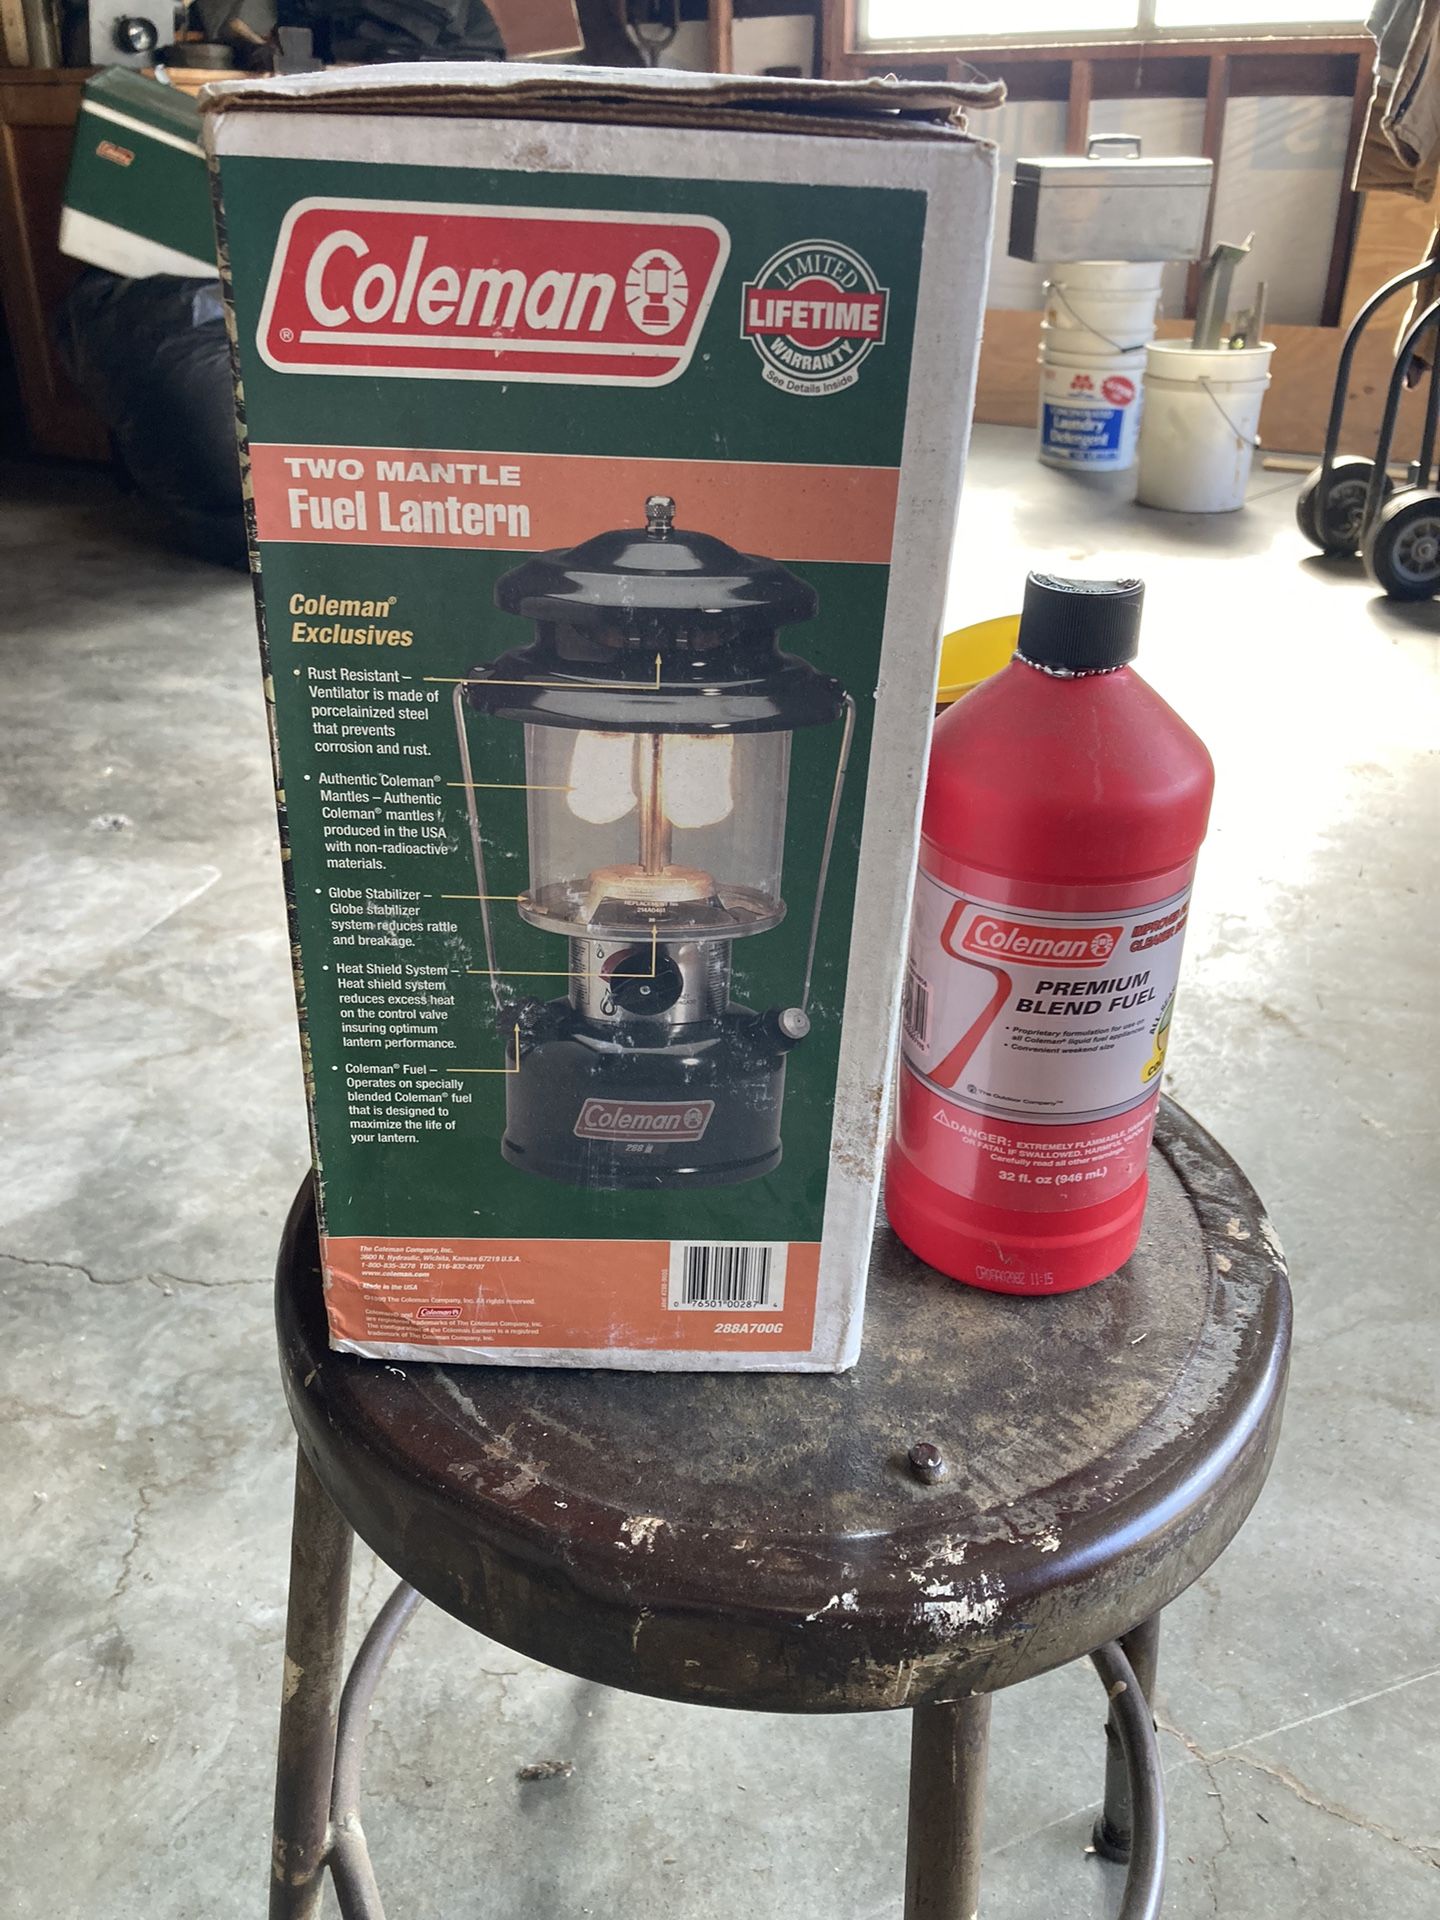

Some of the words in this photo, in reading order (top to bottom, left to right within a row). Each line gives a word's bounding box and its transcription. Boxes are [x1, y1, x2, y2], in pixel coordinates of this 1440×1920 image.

[774, 253, 858, 289] LIMITED
[305, 229, 620, 332] Coleman
[749, 298, 880, 332] LIFETIME
[769, 336, 855, 371] WARRANTY
[766, 370, 785, 386] See
[786, 380, 821, 394] Details
[823, 375, 854, 392] Inside
[283, 457, 365, 481] TWO
[375, 460, 522, 487] MANTLE
[287, 487, 368, 531] Fuel
[378, 491, 531, 538] Lantern
[291, 622, 414, 647] Exclusives
[307, 667, 337, 681] Rust
[340, 668, 400, 683] Resistant
[308, 686, 371, 700] Ventilator
[373, 688, 384, 701] is
[387, 689, 423, 702] made
[426, 690, 439, 702] of
[311, 705, 395, 720] porcelainized
[398, 708, 429, 720] steel
[313, 722, 338, 735] that
[341, 723, 396, 737] prevents
[314, 742, 373, 754] corrosion
[376, 743, 399, 755] and
[403, 744, 431, 756] rust.
[318, 773, 377, 786] Authentic
[320, 790, 370, 803] Mantles
[384, 792, 442, 805] Authentic
[386, 808, 434, 821] mantles
[324, 824, 380, 838] produced
[384, 825, 396, 837] in
[399, 826, 418, 838] the
[421, 827, 447, 839] USA
[326, 841, 351, 853] with
[355, 842, 448, 855] non-radioactive
[327, 857, 387, 870] materials.
[328, 887, 362, 899] Globe
[365, 888, 421, 901] Stabilizer
[330, 904, 363, 915] Globe
[367, 904, 421, 917] stabilizer
[331, 920, 374, 932] system
[377, 921, 424, 933] reduces
[427, 922, 458, 933] rattle
[333, 935, 355, 946] and
[358, 935, 416, 949] breakage.
[975, 921, 1088, 958] Coleman
[336, 964, 363, 975] Heat
[367, 964, 402, 975] Shield
[405, 965, 448, 977] System
[338, 979, 364, 990] Heat
[367, 979, 402, 990] shield
[405, 981, 446, 992] system
[1035, 970, 1151, 996] PREMIUM
[339, 993, 385, 1005] reduces
[388, 995, 427, 1006] excess
[430, 995, 455, 1006] heat
[1016, 998, 1102, 1016] BLEND
[1108, 987, 1156, 1012] FUEL
[340, 1010, 354, 1019] on
[357, 1009, 375, 1019] the
[378, 1009, 417, 1020] control
[419, 1010, 448, 1020] valve
[342, 1023, 386, 1035] insuring
[389, 1024, 438, 1035] optimum
[1013, 1026, 1061, 1038] Proprietary
[1063, 1027, 1109, 1038] formulation
[1111, 1025, 1122, 1033] for
[1123, 1022, 1136, 1031] use
[1068, 1037, 1092, 1046] liquid
[1093, 1035, 1108, 1043] fuel
[1109, 1026, 1145, 1041] appliances
[343, 1037, 381, 1048] lantern
[384, 1038, 457, 1050] performance.
[1011, 1043, 1060, 1054] Convenient
[1061, 1046, 1098, 1054] weekend
[1099, 1043, 1115, 1051] size
[403, 1064, 427, 1075] Fuel
[347, 1078, 396, 1089] Operates
[399, 1080, 413, 1089] on
[415, 1079, 464, 1090] specially
[348, 1092, 391, 1102] blended
[451, 1093, 472, 1103] fuel
[349, 1106, 370, 1116] that
[373, 1107, 383, 1116] is
[386, 1106, 435, 1118] designed
[438, 1108, 449, 1117] to
[584, 1104, 682, 1130] Coleman
[350, 1120, 402, 1130] maximize
[405, 1120, 423, 1130] the
[425, 1120, 442, 1130] life
[445, 1121, 456, 1130] of
[351, 1134, 375, 1144] your
[378, 1133, 420, 1143] lantern.
[950, 1120, 1012, 1146] DANGER:
[1016, 1141, 1073, 1151] EXTREMELY
[1074, 1130, 1126, 1149] FLAMMABLE,
[962, 1136, 976, 1146] OR
[977, 1141, 1006, 1155] FATAL
[1019, 1147, 1083, 1159] SWALLOWED.
[1085, 1140, 1122, 1156] HARMFUL
[990, 1154, 1030, 1167] Carefully
[1033, 1158, 1053, 1167] read
[1055, 1158, 1066, 1167] all
[1067, 1157, 1091, 1166] other
[998, 1170, 1015, 1181] 32
[1019, 1173, 1031, 1183] fl.
[1035, 1176, 1052, 1184] oz
[1055, 1172, 1082, 1186] (946
[1085, 1167, 1108, 1180] mL)
[362, 1282, 381, 1290] Made
[692, 1300, 722, 1308] 76501
[714, 1323, 784, 1334] 288A700G
